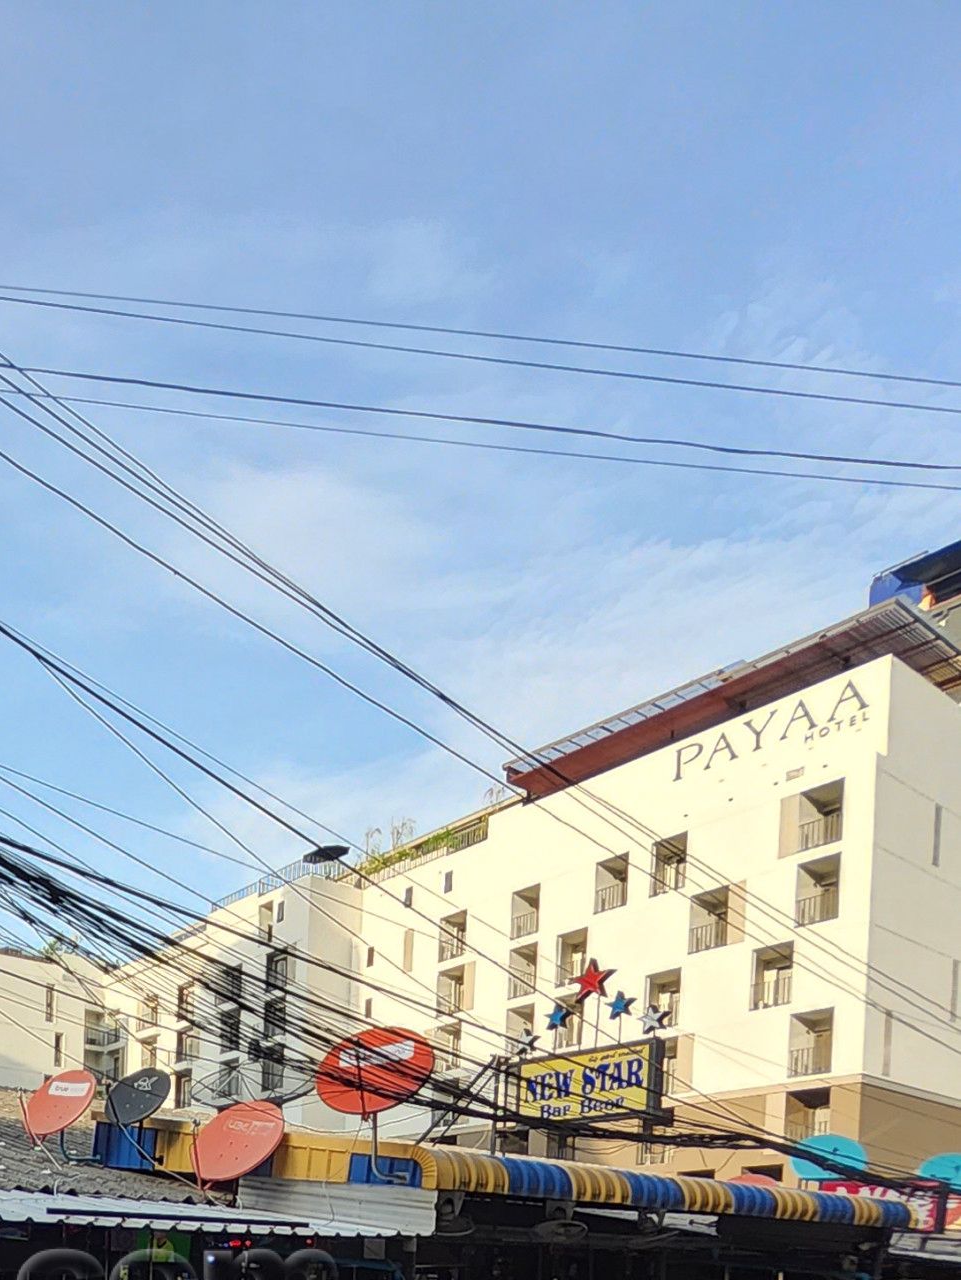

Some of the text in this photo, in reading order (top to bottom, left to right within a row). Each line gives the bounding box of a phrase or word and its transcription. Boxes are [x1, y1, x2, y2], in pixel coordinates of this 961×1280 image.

[672, 679, 869, 782] PAYAA
[804, 712, 870, 744] HOTEL
[524, 1057, 644, 1103] NEW STAR
[540, 1104, 571, 1120] Bar
